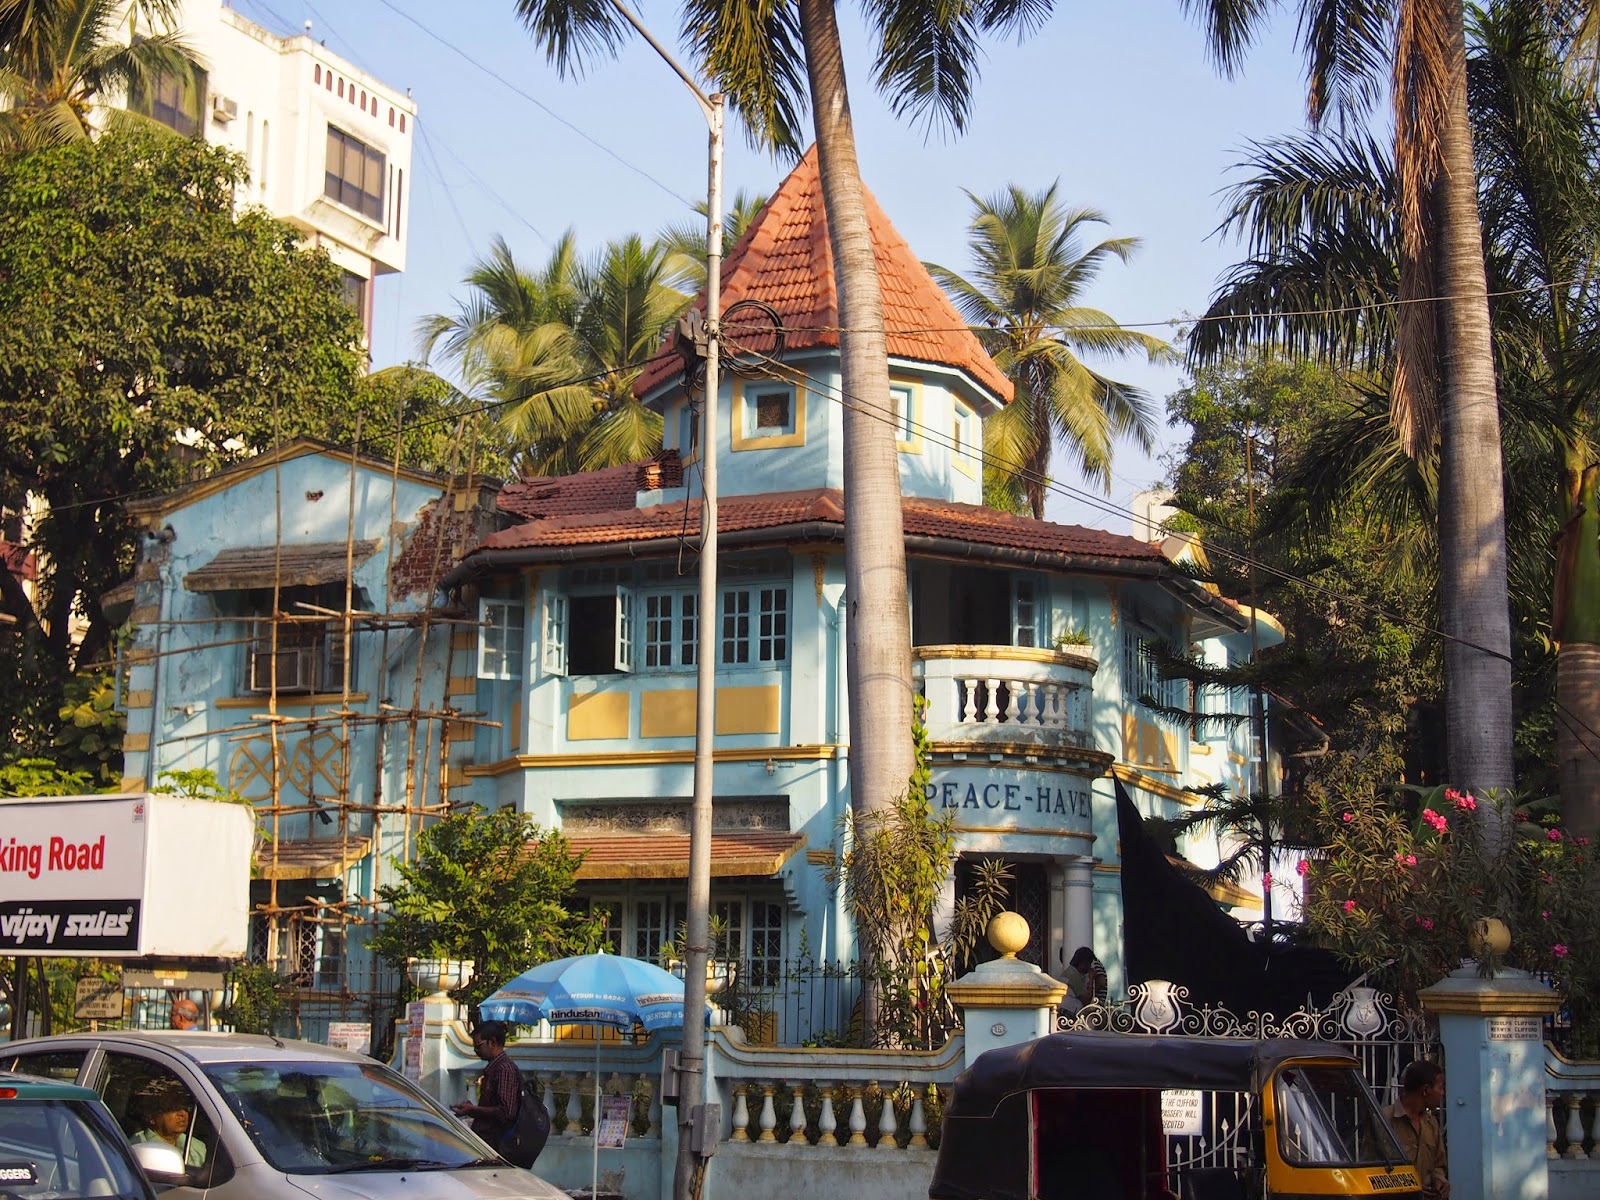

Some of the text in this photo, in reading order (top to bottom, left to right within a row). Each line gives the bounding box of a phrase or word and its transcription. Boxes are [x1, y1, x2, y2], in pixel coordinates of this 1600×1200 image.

[48, 835, 105, 871] Road
[1, 907, 133, 944] vijay sales
[1176, 1098, 1199, 1107] CLIFFORD
[1184, 1110, 1198, 1118] WILL
